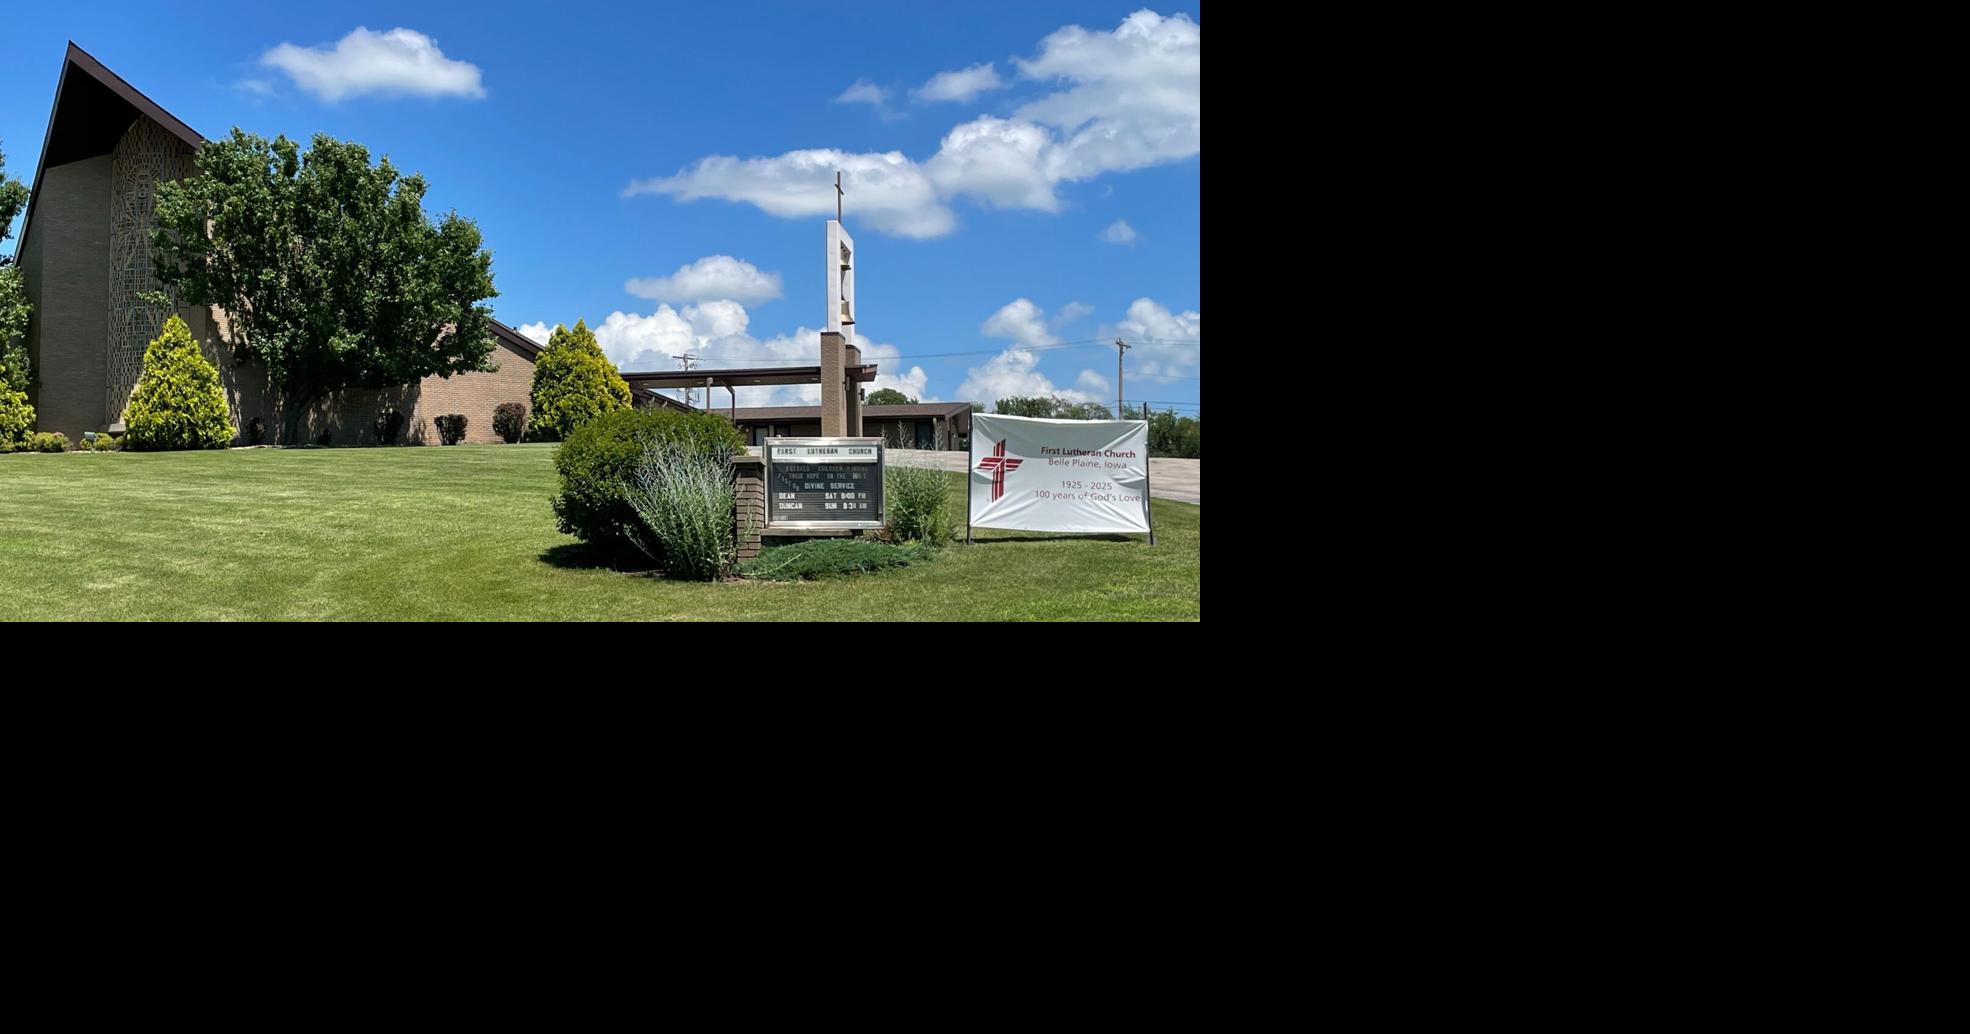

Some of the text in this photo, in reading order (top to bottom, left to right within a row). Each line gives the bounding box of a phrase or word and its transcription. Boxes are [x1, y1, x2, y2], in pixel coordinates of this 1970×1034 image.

[1041, 446, 1136, 458] First Lutheran Church
[1048, 458, 1127, 469] Belle Plaine, Iowa
[804, 482, 855, 490] DIVINE SERVICE
[1061, 480, 1082, 489] 1925
[1090, 482, 1113, 491] 2025
[1035, 490, 1141, 503] 100 years of God's Love
